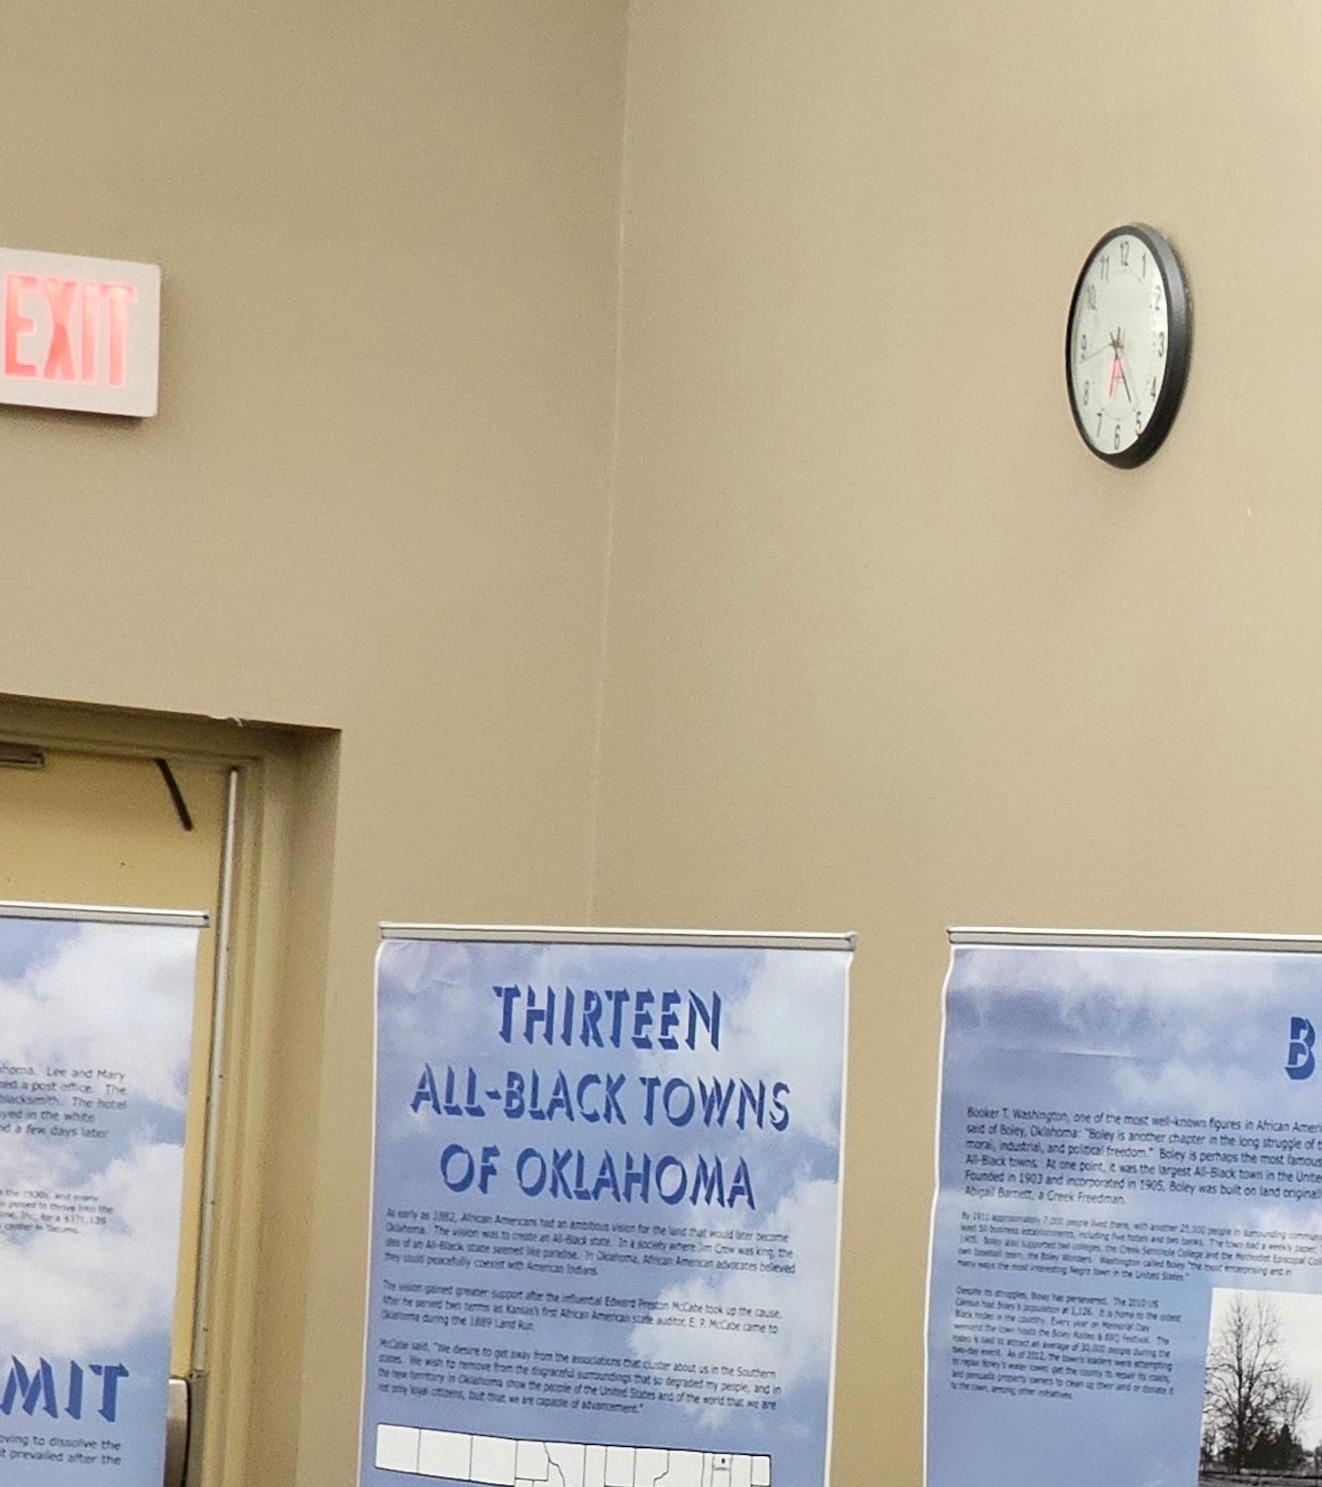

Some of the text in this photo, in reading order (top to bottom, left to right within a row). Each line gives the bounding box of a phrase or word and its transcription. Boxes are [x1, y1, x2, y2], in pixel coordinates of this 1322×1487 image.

[4, 273, 137, 388] EXIT
[493, 985, 721, 1050] THIRTEEN
[411, 1064, 789, 1131] ALL-BLACK TOWNS
[967, 1106, 999, 1118] Booker
[1073, 1114, 1091, 1122] one
[1094, 1111, 1103, 1123] of
[1106, 1111, 1121, 1124] the
[1123, 1113, 1148, 1125] most
[1152, 1114, 1206, 1128] well-known
[1209, 1116, 1241, 1132] figures
[1245, 1118, 1254, 1130] in
[1256, 1119, 1289, 1132] African
[441, 1144, 755, 1210] OF OKLAHOMA
[32, 1435, 121, 1450] to dissolve the
